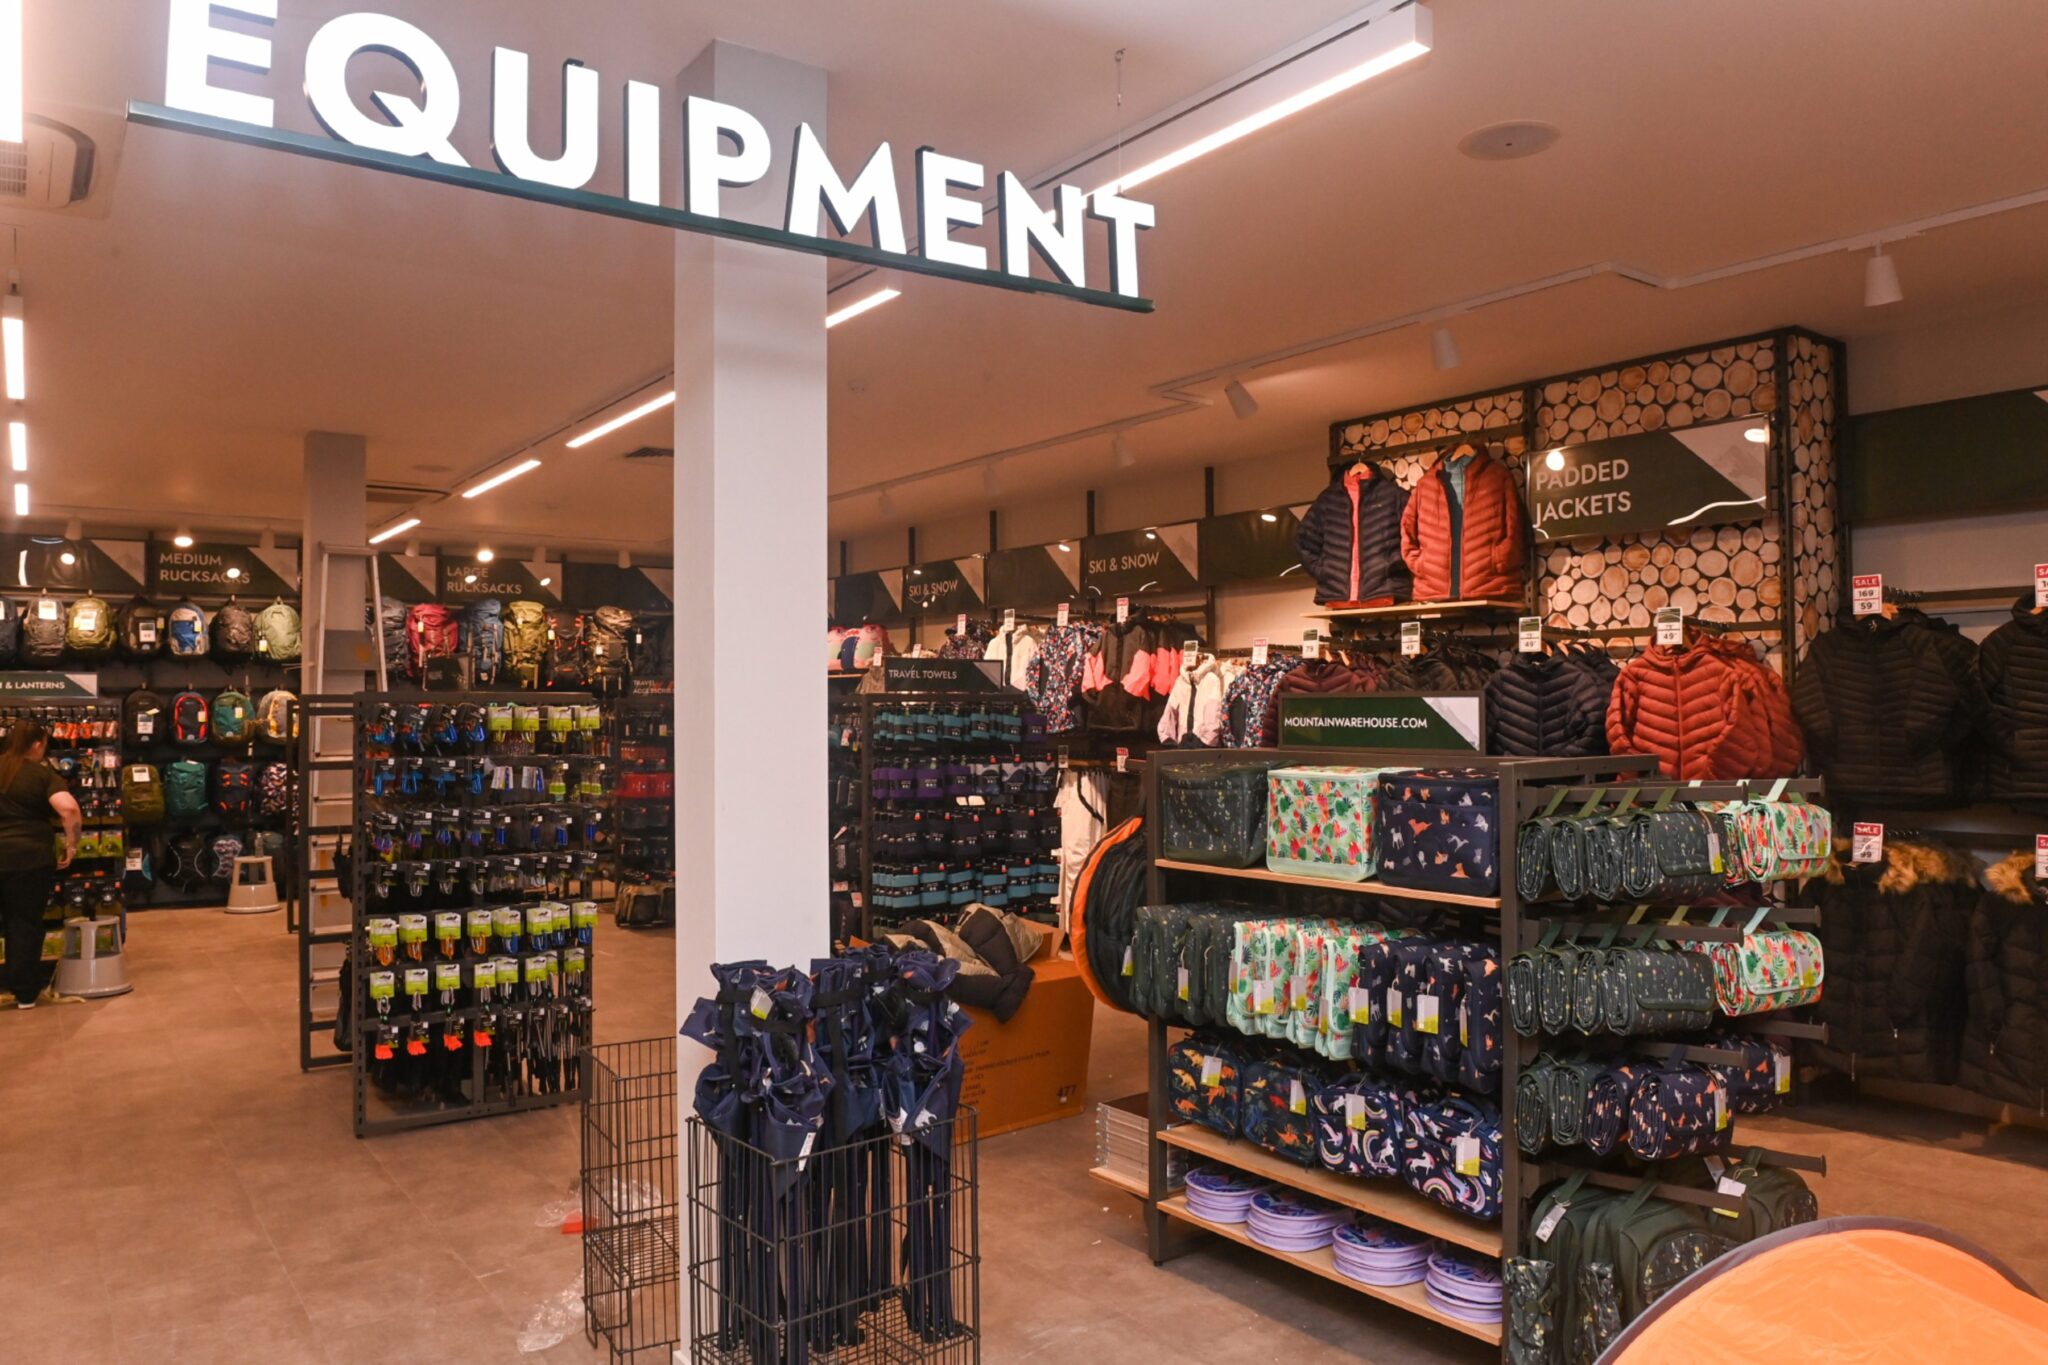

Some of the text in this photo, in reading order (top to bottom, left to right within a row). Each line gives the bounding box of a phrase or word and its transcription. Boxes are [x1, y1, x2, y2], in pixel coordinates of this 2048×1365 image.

[164, 0, 1156, 299] EQUIPMENT
[1536, 458, 1630, 491] PADDED
[1533, 491, 1632, 528] JACKETS
[159, 553, 222, 566] MEDIUM
[1088, 551, 1160, 574] SKI & SNOW
[447, 566, 489, 578] LARGE
[446, 581, 524, 595] RUCKSACKS
[908, 584, 922, 597] SKI
[930, 579, 959, 594] SNOW
[1855, 579, 1878, 587] SALE
[1858, 589, 1875, 597] 169
[1860, 602, 1873, 610] 59
[888, 669, 958, 680] TRAVEL TOWELS
[5, 682, 13, 690] &
[15, 681, 66, 690] LANTERNS
[1284, 716, 1428, 729] MOUNTAINWAREHOUSE.COM
